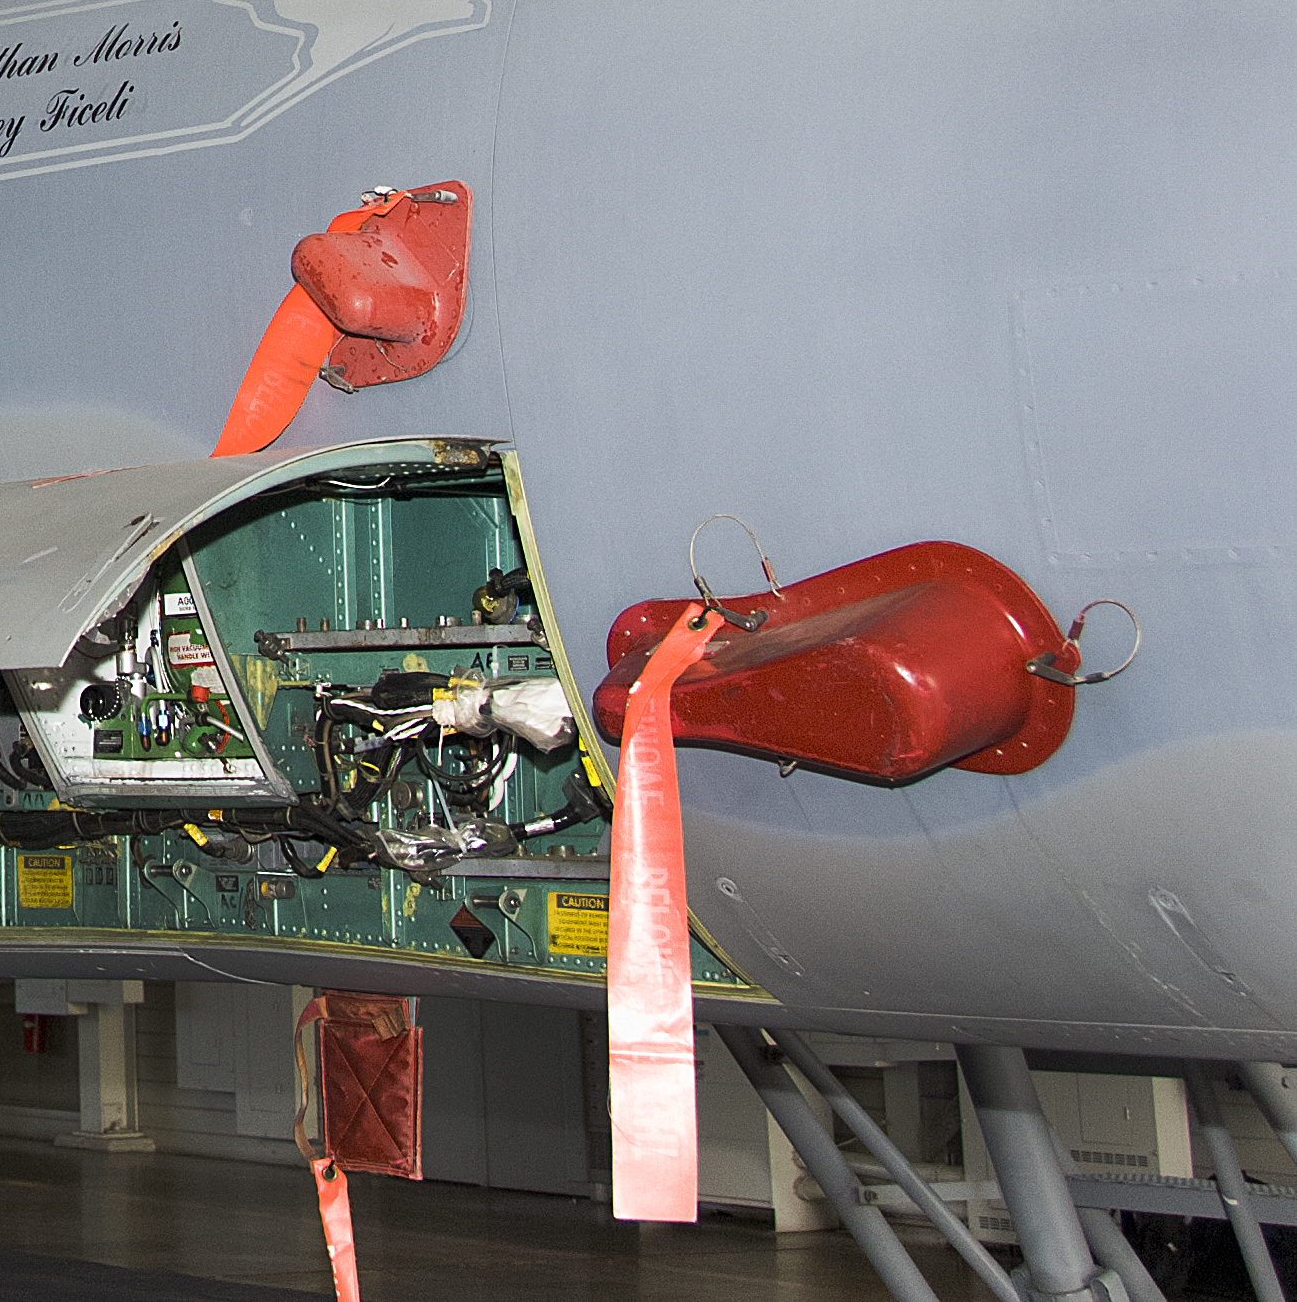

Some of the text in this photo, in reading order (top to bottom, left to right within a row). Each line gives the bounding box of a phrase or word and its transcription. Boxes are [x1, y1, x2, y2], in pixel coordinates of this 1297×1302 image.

[74, 20, 183, 68] Morris
[28, 858, 61, 867] CAUTION
[561, 895, 605, 909] CAUTION
